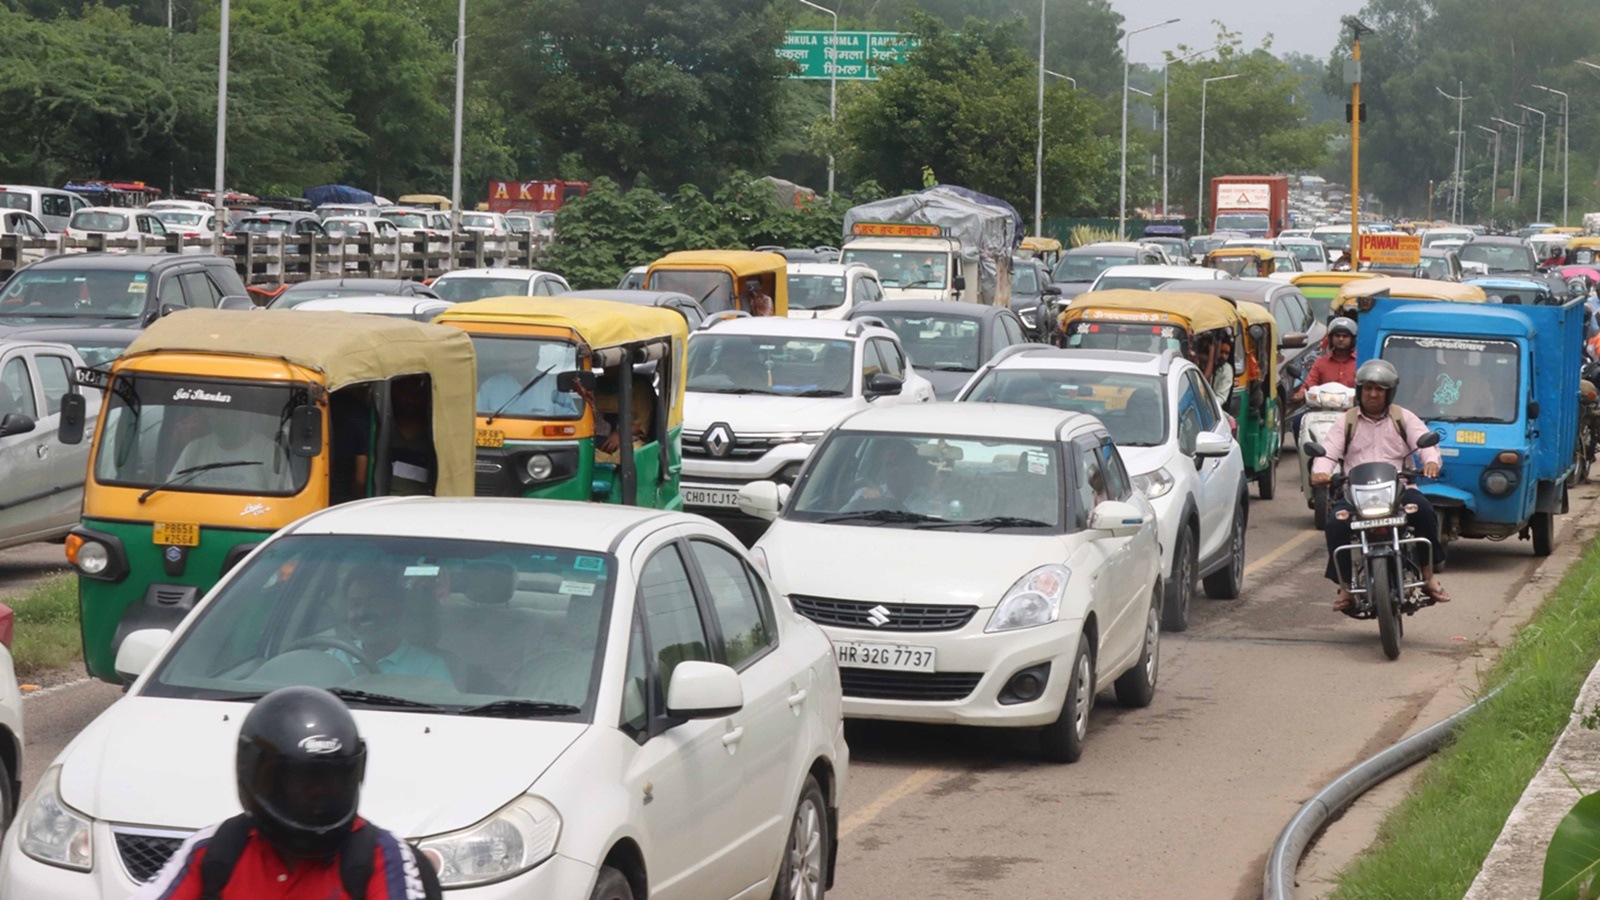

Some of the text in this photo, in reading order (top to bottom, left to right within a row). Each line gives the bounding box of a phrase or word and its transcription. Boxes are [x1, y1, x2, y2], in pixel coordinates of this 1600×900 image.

[1365, 235, 1399, 250] PAWAN
[173, 388, 232, 403] Jai Shankar
[685, 490, 738, 505] CH01CJ12
[839, 646, 932, 668] HR 32G 7737
